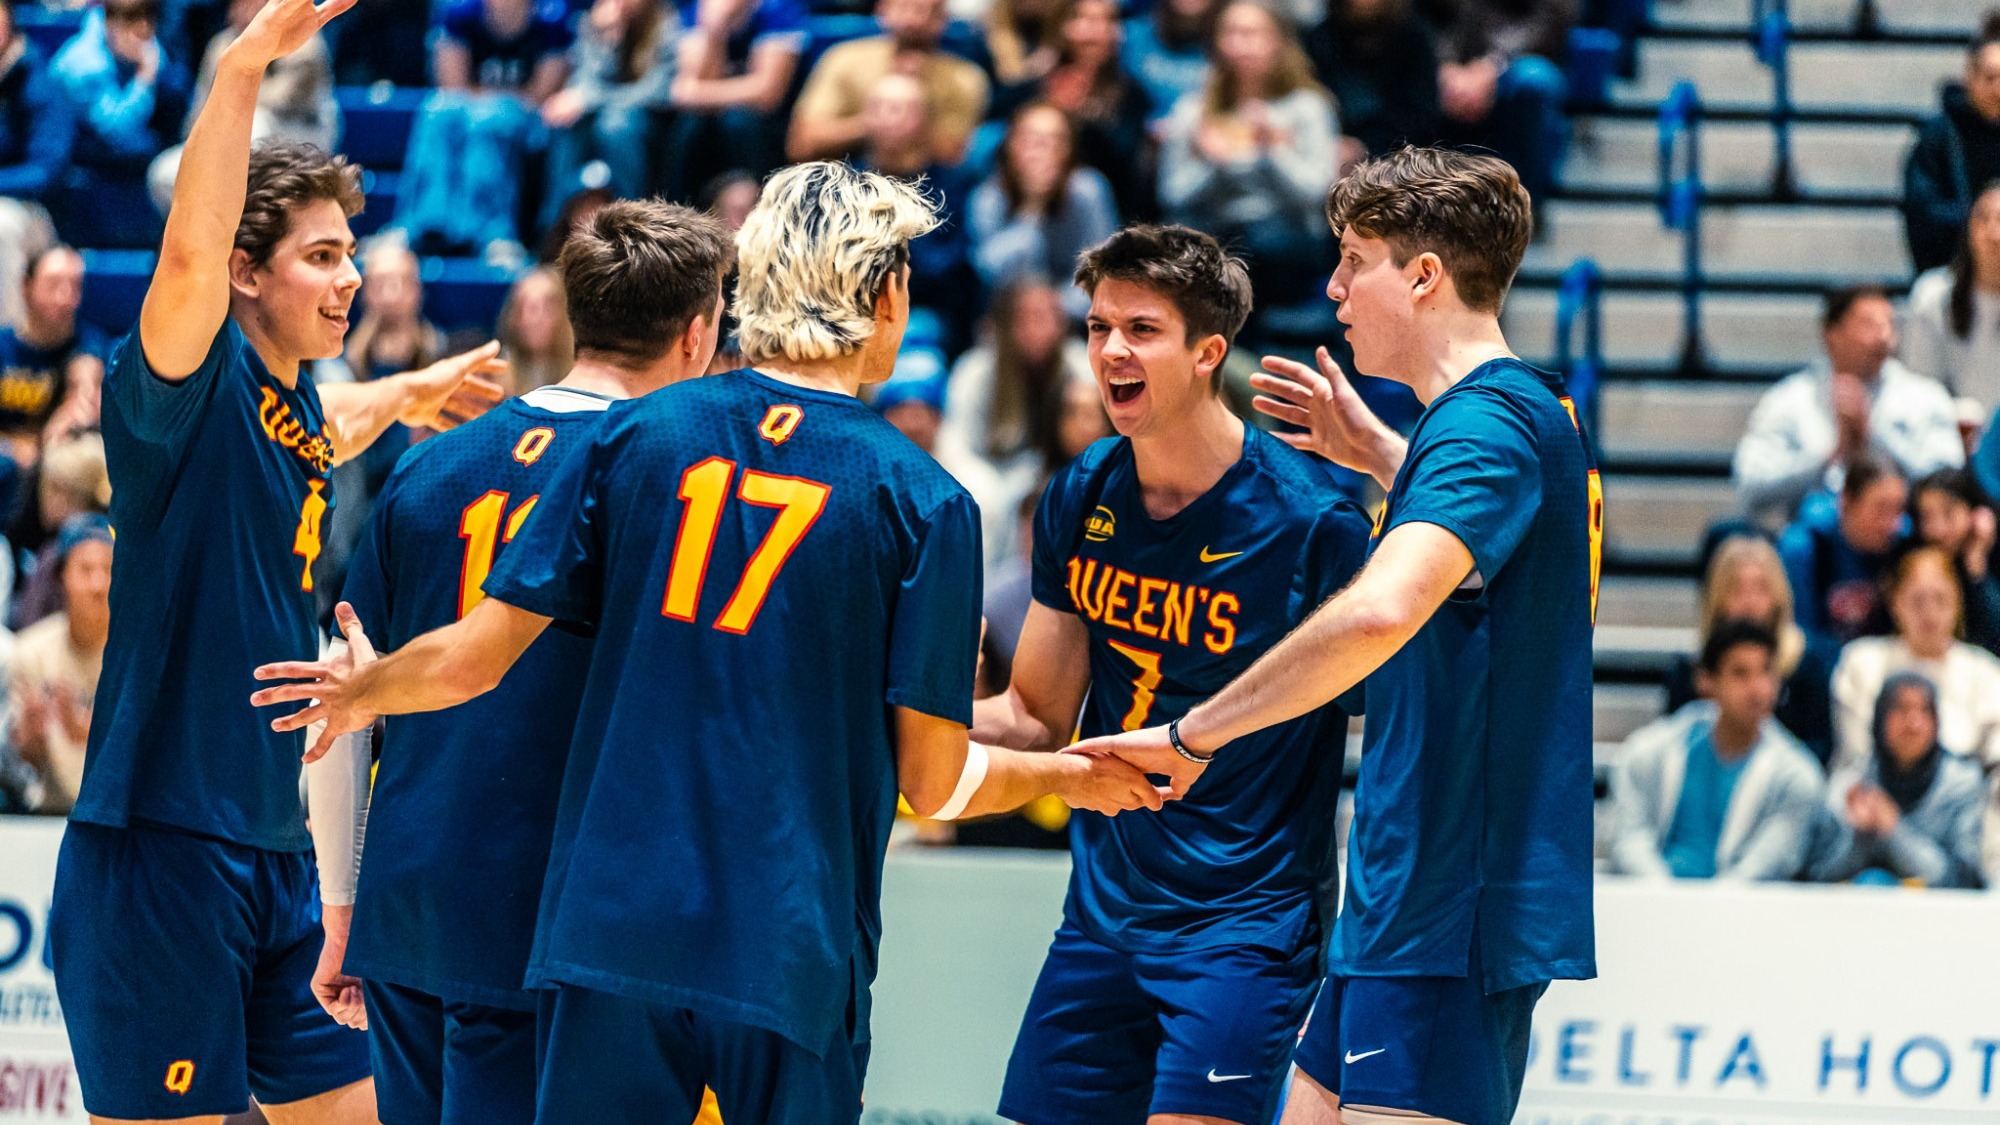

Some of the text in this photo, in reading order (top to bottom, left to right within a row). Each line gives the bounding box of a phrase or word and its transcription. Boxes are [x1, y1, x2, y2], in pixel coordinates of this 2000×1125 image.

[512, 426, 555, 467] Q
[758, 404, 804, 446] Q
[293, 478, 327, 592] 4
[457, 489, 540, 622] 1
[661, 455, 832, 635] 17
[1108, 638, 1163, 733] 7
[164, 1059, 196, 1096] Q
[1528, 1019, 1768, 1087] ELTA
